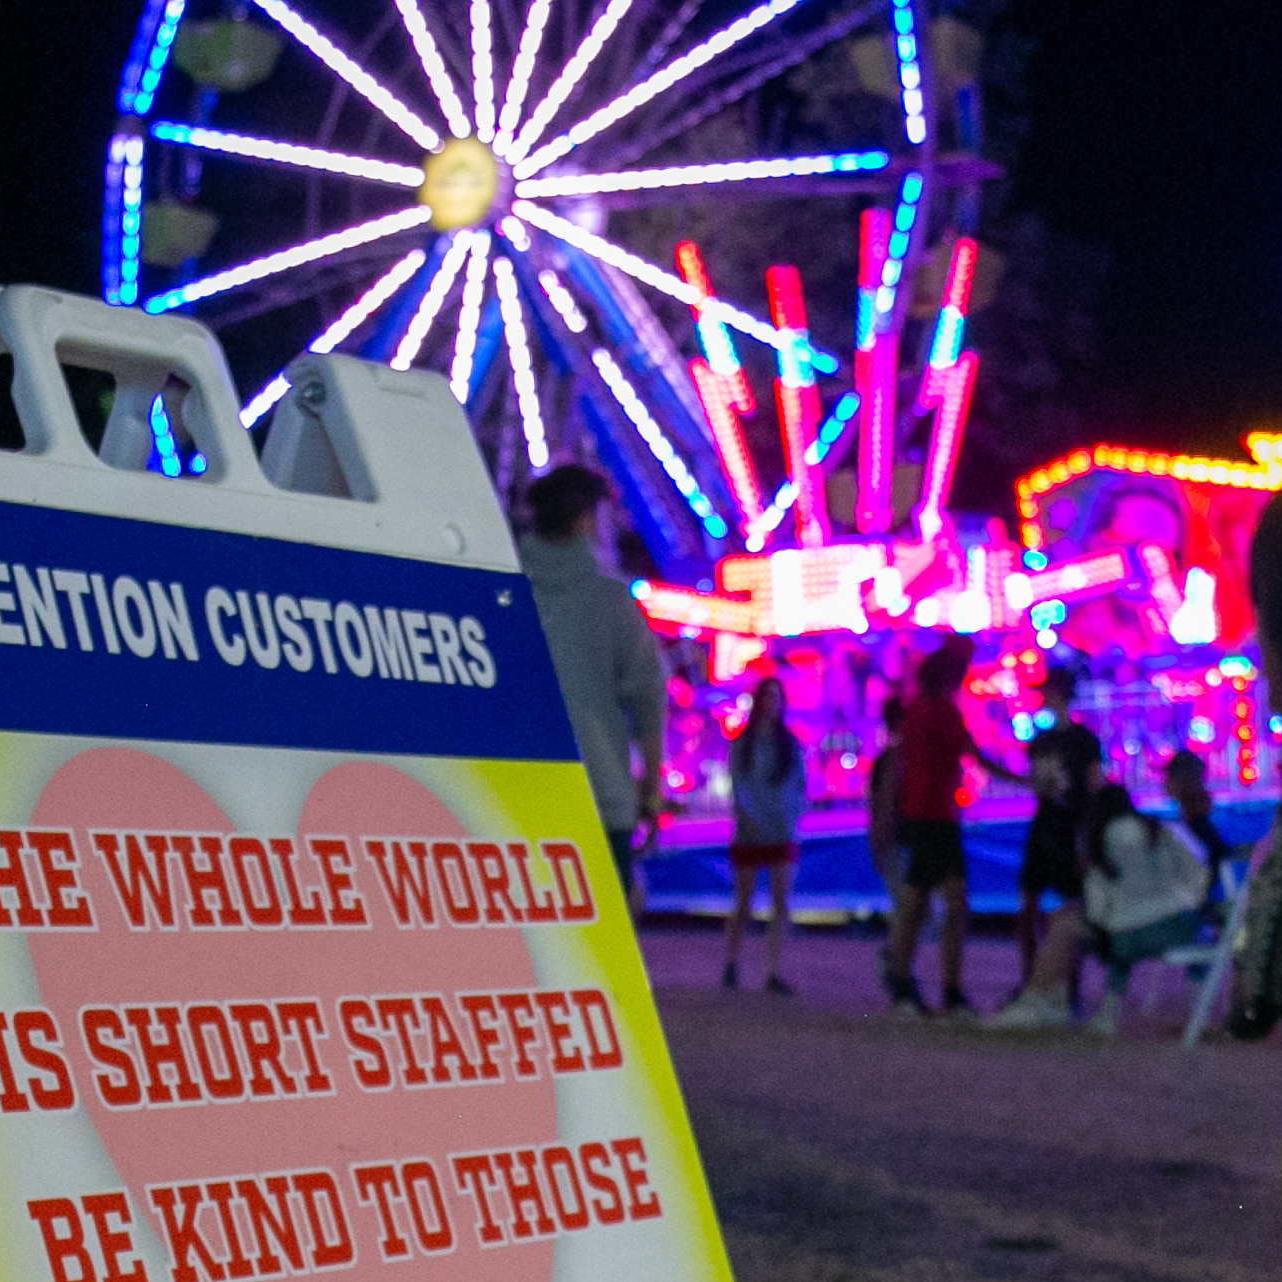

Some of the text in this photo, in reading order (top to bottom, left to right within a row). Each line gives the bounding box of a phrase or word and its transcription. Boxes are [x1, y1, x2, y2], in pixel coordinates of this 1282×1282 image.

[204, 586, 496, 688] CUSTOMERS
[93, 833, 367, 927] WHOLE
[365, 840, 595, 924] WORLD
[81, 1001, 331, 1106] SHORT
[339, 989, 623, 1087] STAFFED
[353, 1161, 453, 1257] TO
[452, 1137, 662, 1242] THOSE
